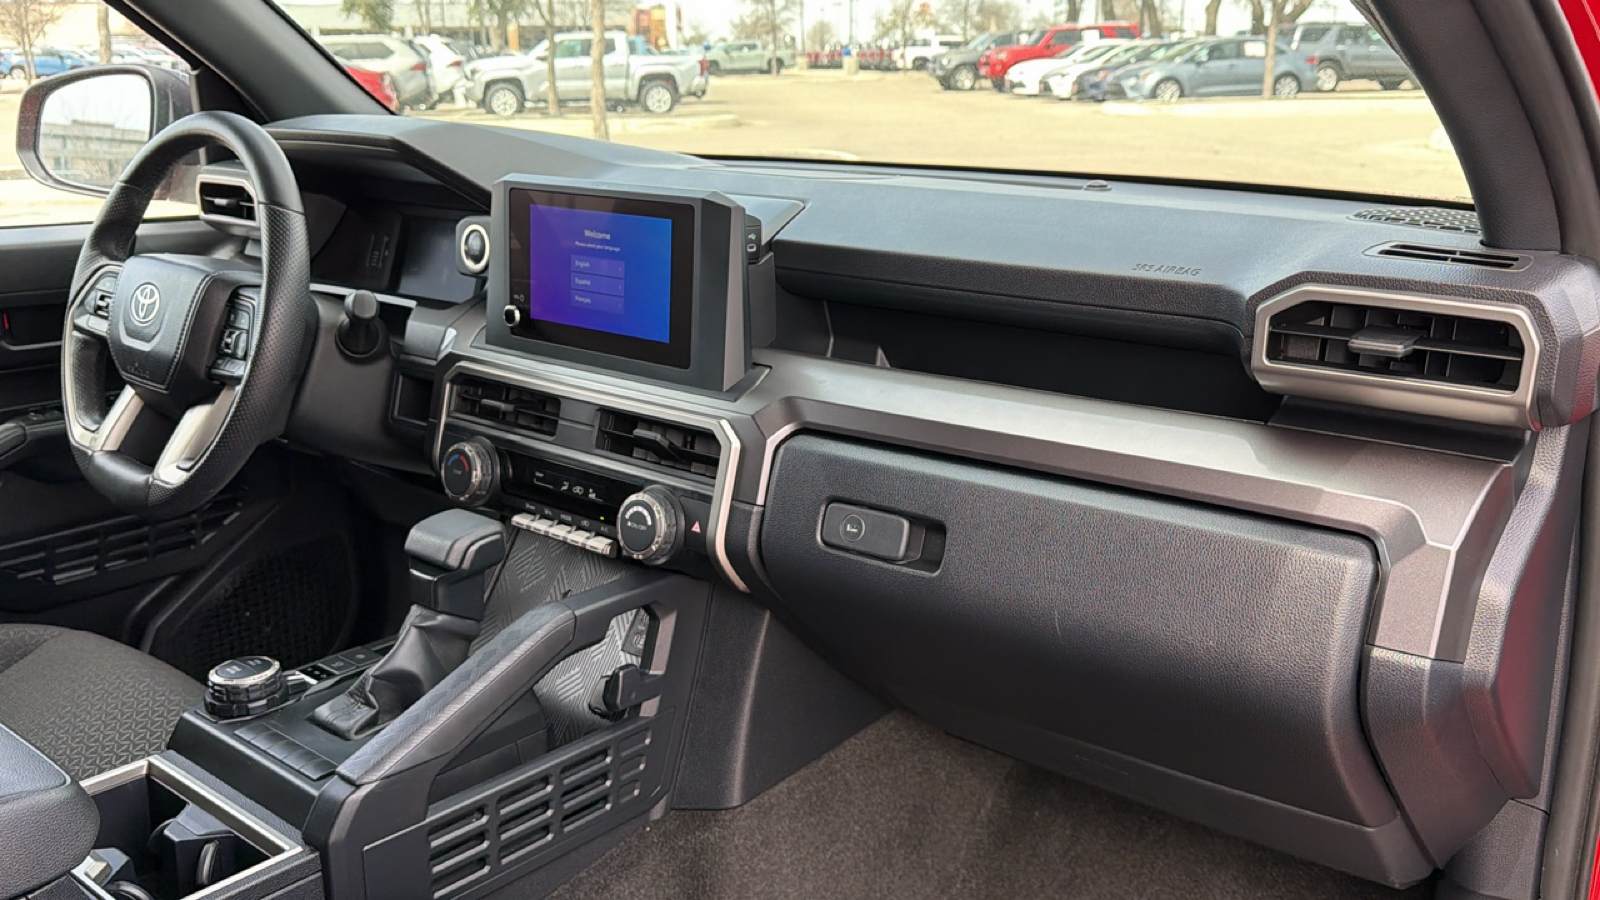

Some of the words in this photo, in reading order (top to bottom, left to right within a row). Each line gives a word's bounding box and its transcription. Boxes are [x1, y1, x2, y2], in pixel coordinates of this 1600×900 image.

[584, 229, 611, 240] Welcome
[575, 260, 590, 268] English
[1132, 264, 1155, 272] SRS
[1154, 265, 1202, 276] AIRBAG
